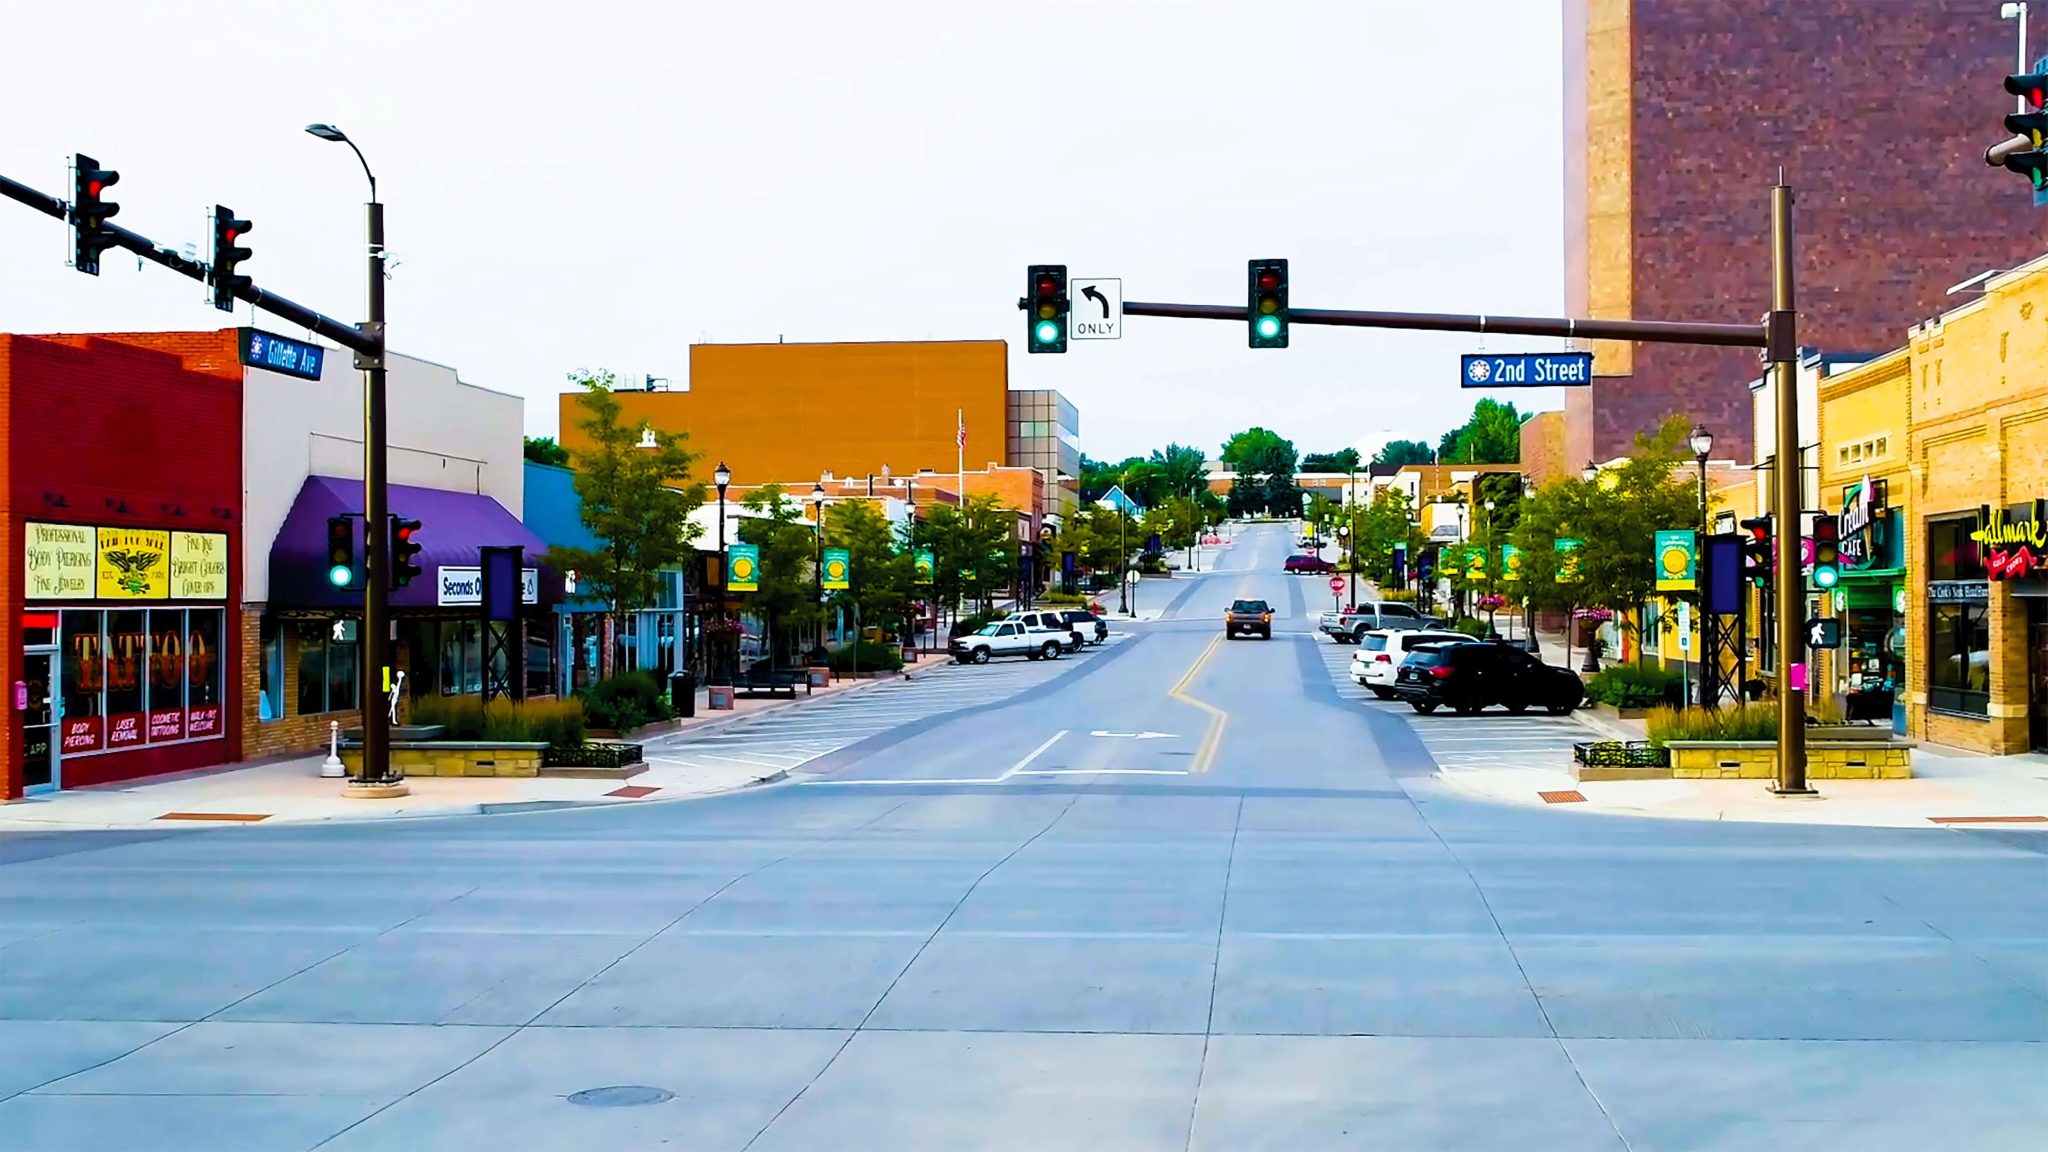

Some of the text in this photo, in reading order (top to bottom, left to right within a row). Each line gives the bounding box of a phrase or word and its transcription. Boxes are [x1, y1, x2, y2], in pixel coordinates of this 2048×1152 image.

[1077, 322, 1115, 335] ONLY
[267, 339, 316, 374] Gillette Ave
[1494, 358, 1585, 383] 2nd Street
[1838, 503, 1870, 541] Cream
[1970, 498, 2047, 567] Hallmark
[1841, 539, 1862, 557] CAFE
[1992, 555, 2006, 568] GOLD
[443, 576, 474, 597] Seconds
[1330, 579, 1344, 588] STOP
[73, 632, 208, 692] TATTOO
[115, 717, 136, 730] LASER
[151, 712, 181, 725] COSMETIC
[71, 722, 91, 735] BODY
[189, 720, 215, 732] WELCOME
[63, 734, 96, 748] PIERCING
[110, 729, 138, 742] REMOVAL
